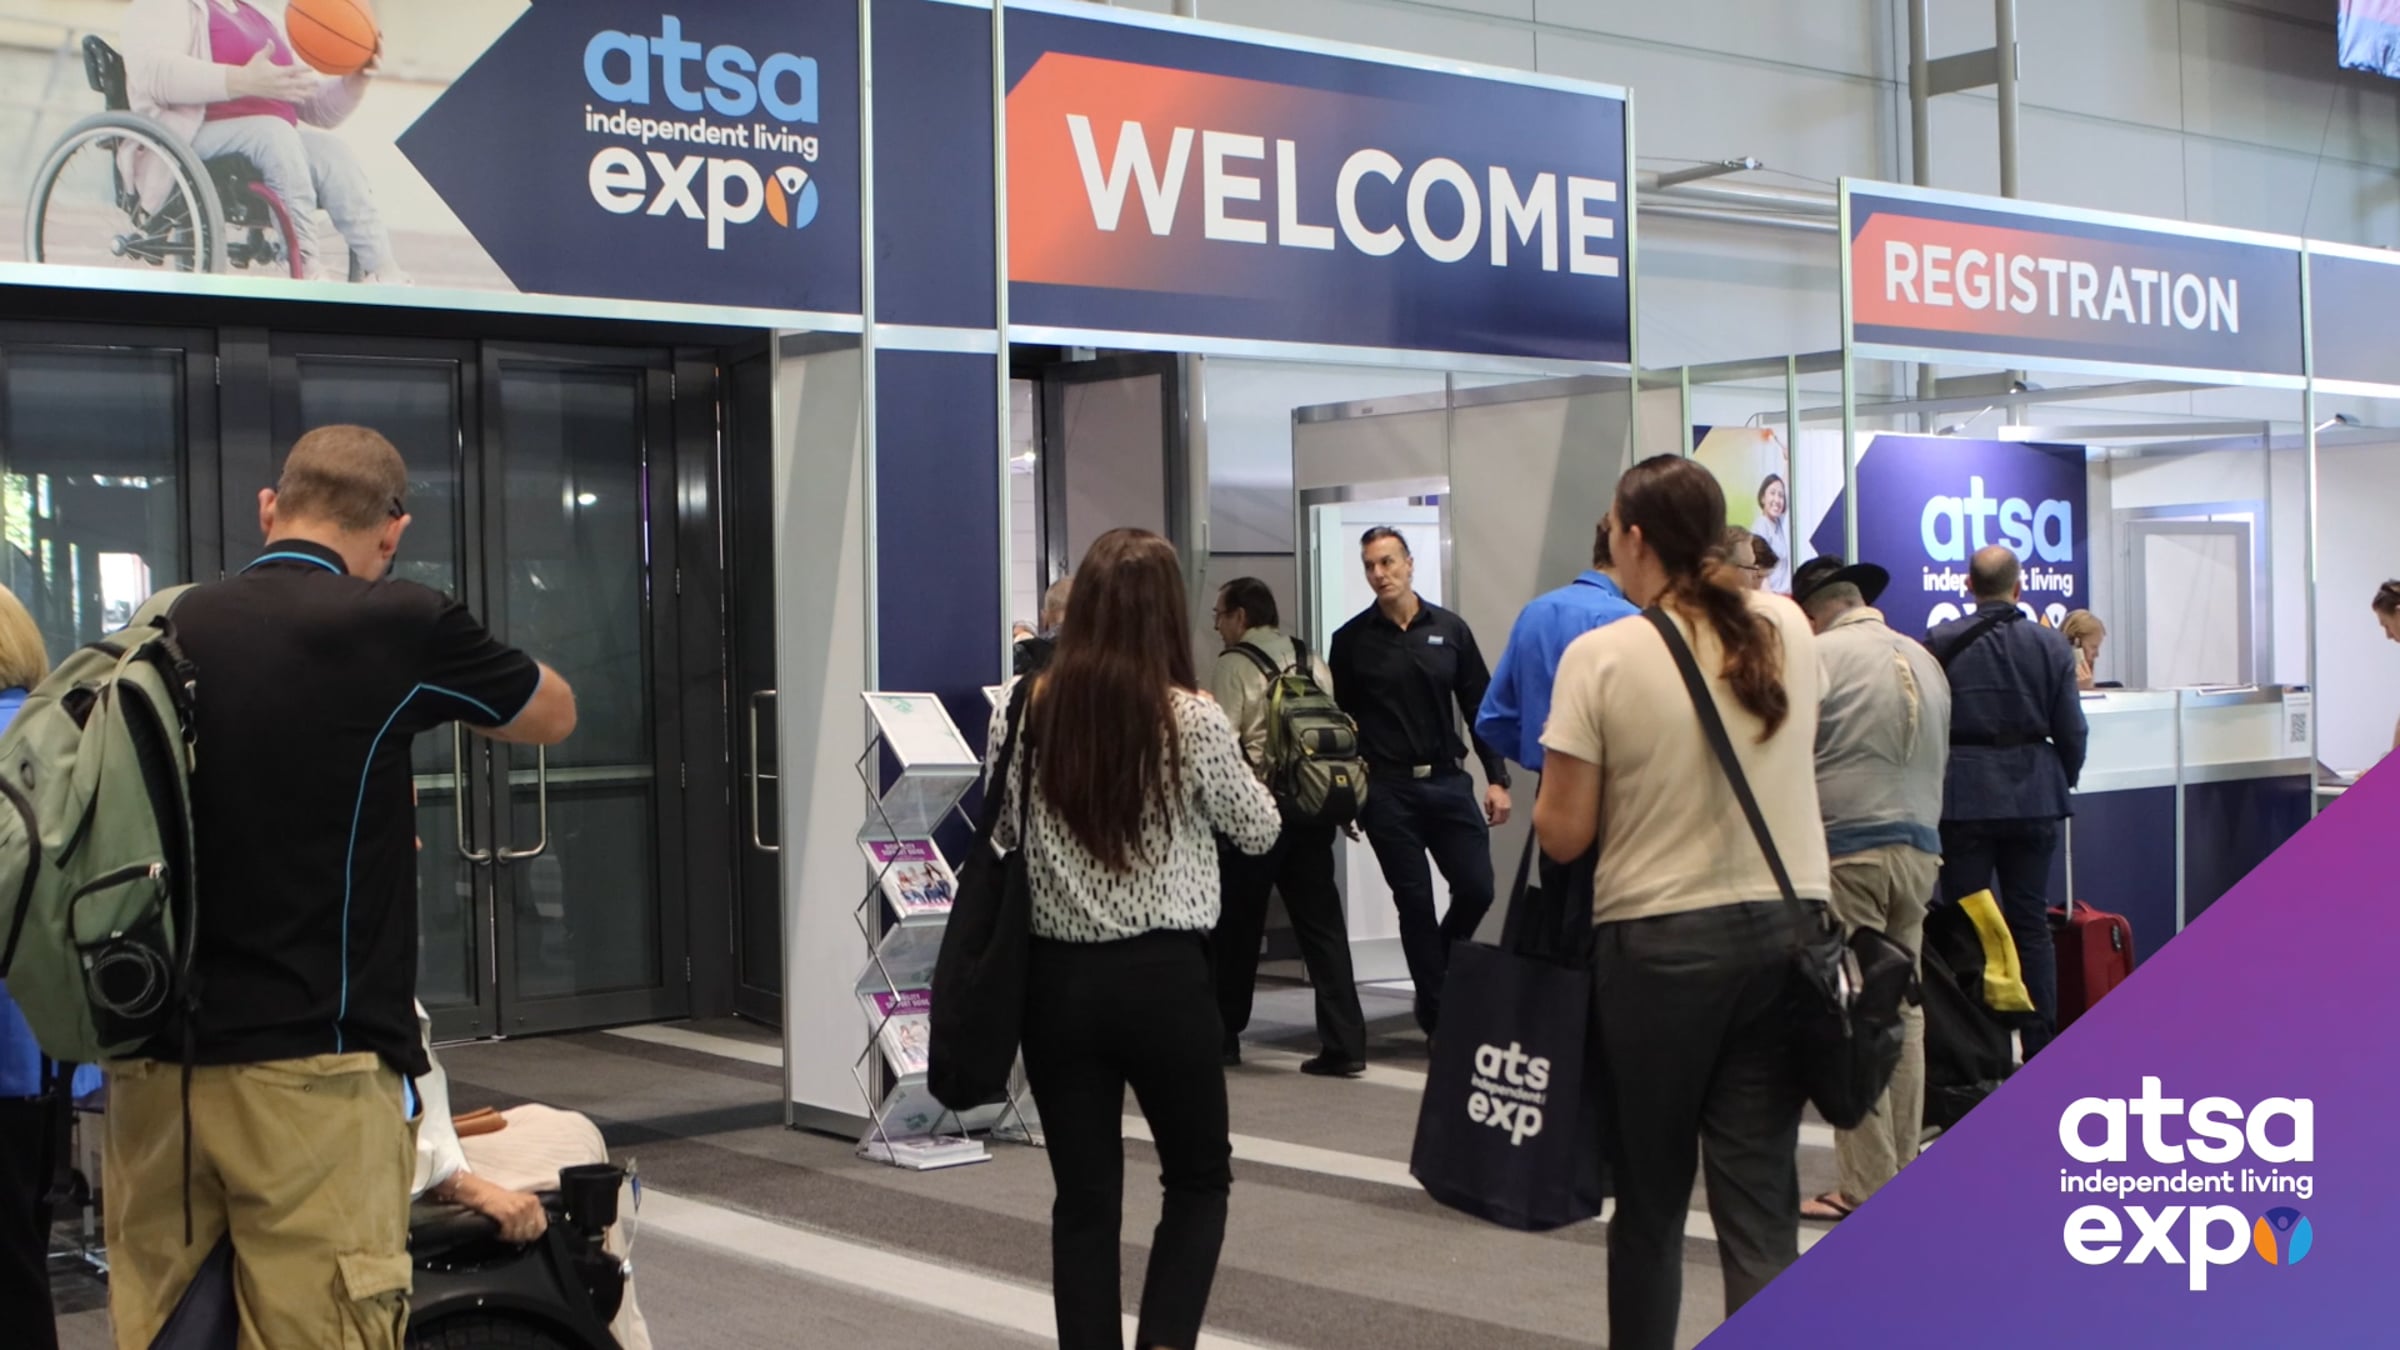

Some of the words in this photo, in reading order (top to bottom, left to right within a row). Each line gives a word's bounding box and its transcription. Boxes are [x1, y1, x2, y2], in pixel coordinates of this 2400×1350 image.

[584, 14, 819, 124] atsa
[585, 105, 750, 148] independent
[754, 124, 819, 163] living
[1065, 113, 1620, 277] WELCOME
[1885, 240, 2240, 333] REGISTRATION
[1921, 475, 2073, 563] atsa
[2031, 567, 2073, 598] living
